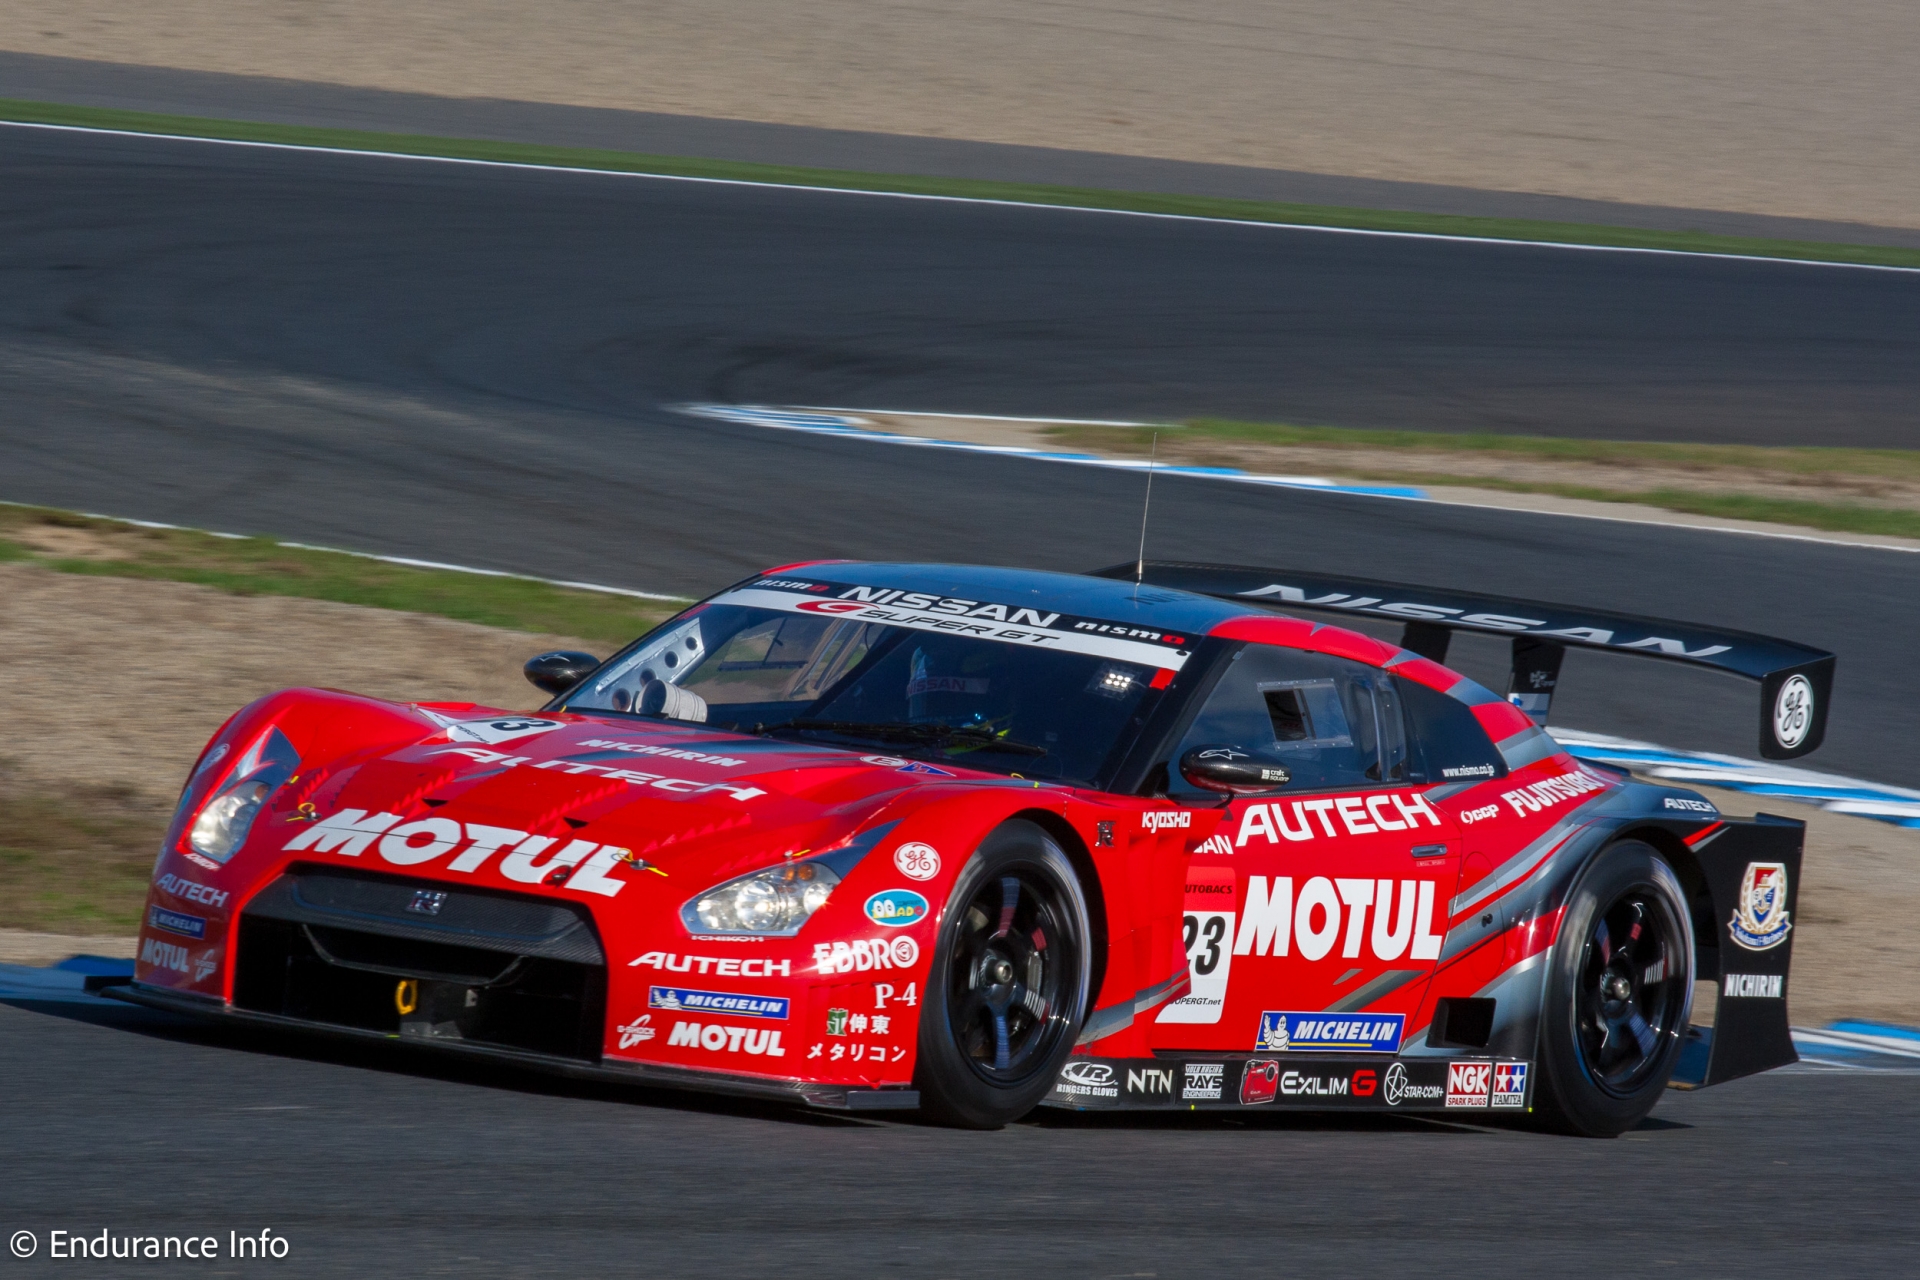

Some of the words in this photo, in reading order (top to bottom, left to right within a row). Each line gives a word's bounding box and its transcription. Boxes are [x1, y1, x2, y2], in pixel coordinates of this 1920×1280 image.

[754, 579, 829, 592] nismo
[837, 586, 1060, 628] NISSAN
[855, 610, 993, 636] SUPER
[994, 629, 1060, 643] GT
[1238, 584, 1733, 656] NISSAN
[1074, 621, 1186, 645] nismo
[577, 739, 747, 767] NICHIRIN
[424, 748, 768, 802] AUTECH
[1443, 763, 1494, 777] www.nismo.co.jp
[1501, 770, 1605, 818] FUJITSUBO
[1665, 797, 1717, 812] AUTECH
[1235, 793, 1442, 847] AUTECH
[281, 808, 630, 898] MOTUL
[156, 872, 230, 908] AUTECH
[1183, 884, 1233, 894] UTOBACS
[158, 913, 203, 932] MICHELIN
[1232, 875, 1443, 962] MOTUL
[141, 937, 190, 973] MOTUL
[812, 935, 919, 974] EBBRO
[1183, 915, 1226, 976] 23
[627, 952, 791, 977] AUTECH
[873, 982, 917, 1009] P-4
[1724, 974, 1783, 998] NICHIRIN
[684, 994, 783, 1013] MICHELIN
[1170, 997, 1222, 1006] UPERGT.net
[849, 1013, 891, 1034] 伸東
[1293, 1020, 1397, 1041] MICHELIN
[667, 1021, 785, 1057] MOTUL
[806, 1043, 906, 1062] メタリコン
[1056, 1084, 1091, 1095] RINGERS
[1092, 1087, 1118, 1097] GLOVES
[1127, 1069, 1173, 1094] NTN
[1184, 1075, 1223, 1089] RAYS
[1280, 1071, 1348, 1095] EXILIM
[1403, 1085, 1444, 1098] STAR-CCM+
[1450, 1066, 1490, 1094] NGK
[1447, 1097, 1466, 1106] SPARK
[1467, 1097, 1487, 1106] PLUGS
[1493, 1095, 1522, 1105] TAMIYA
